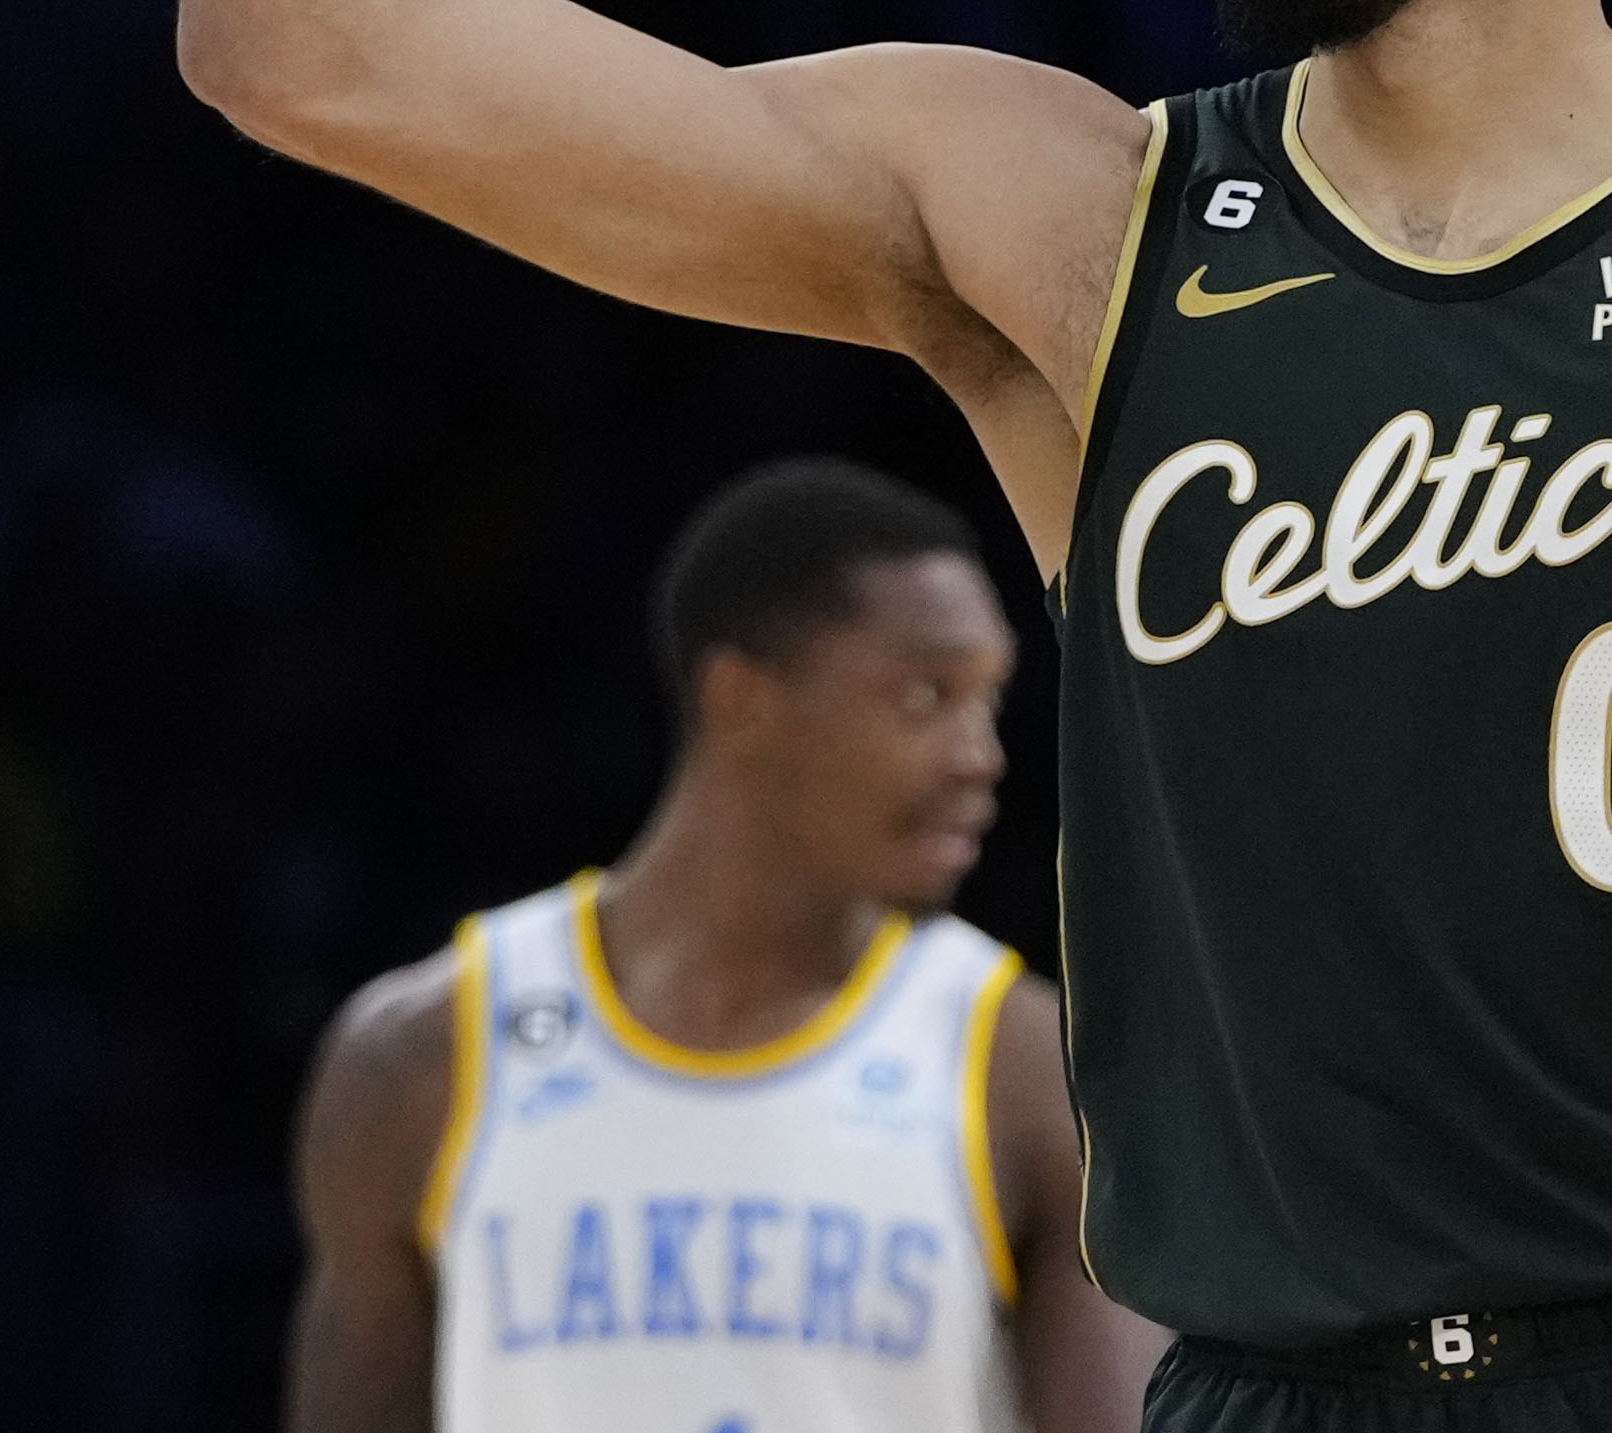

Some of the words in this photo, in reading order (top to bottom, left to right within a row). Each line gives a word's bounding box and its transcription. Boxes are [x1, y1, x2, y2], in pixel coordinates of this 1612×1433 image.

[1203, 179, 1264, 229] 6
[484, 1196, 944, 1360] LAKERS
[1430, 1314, 1475, 1365] 6
